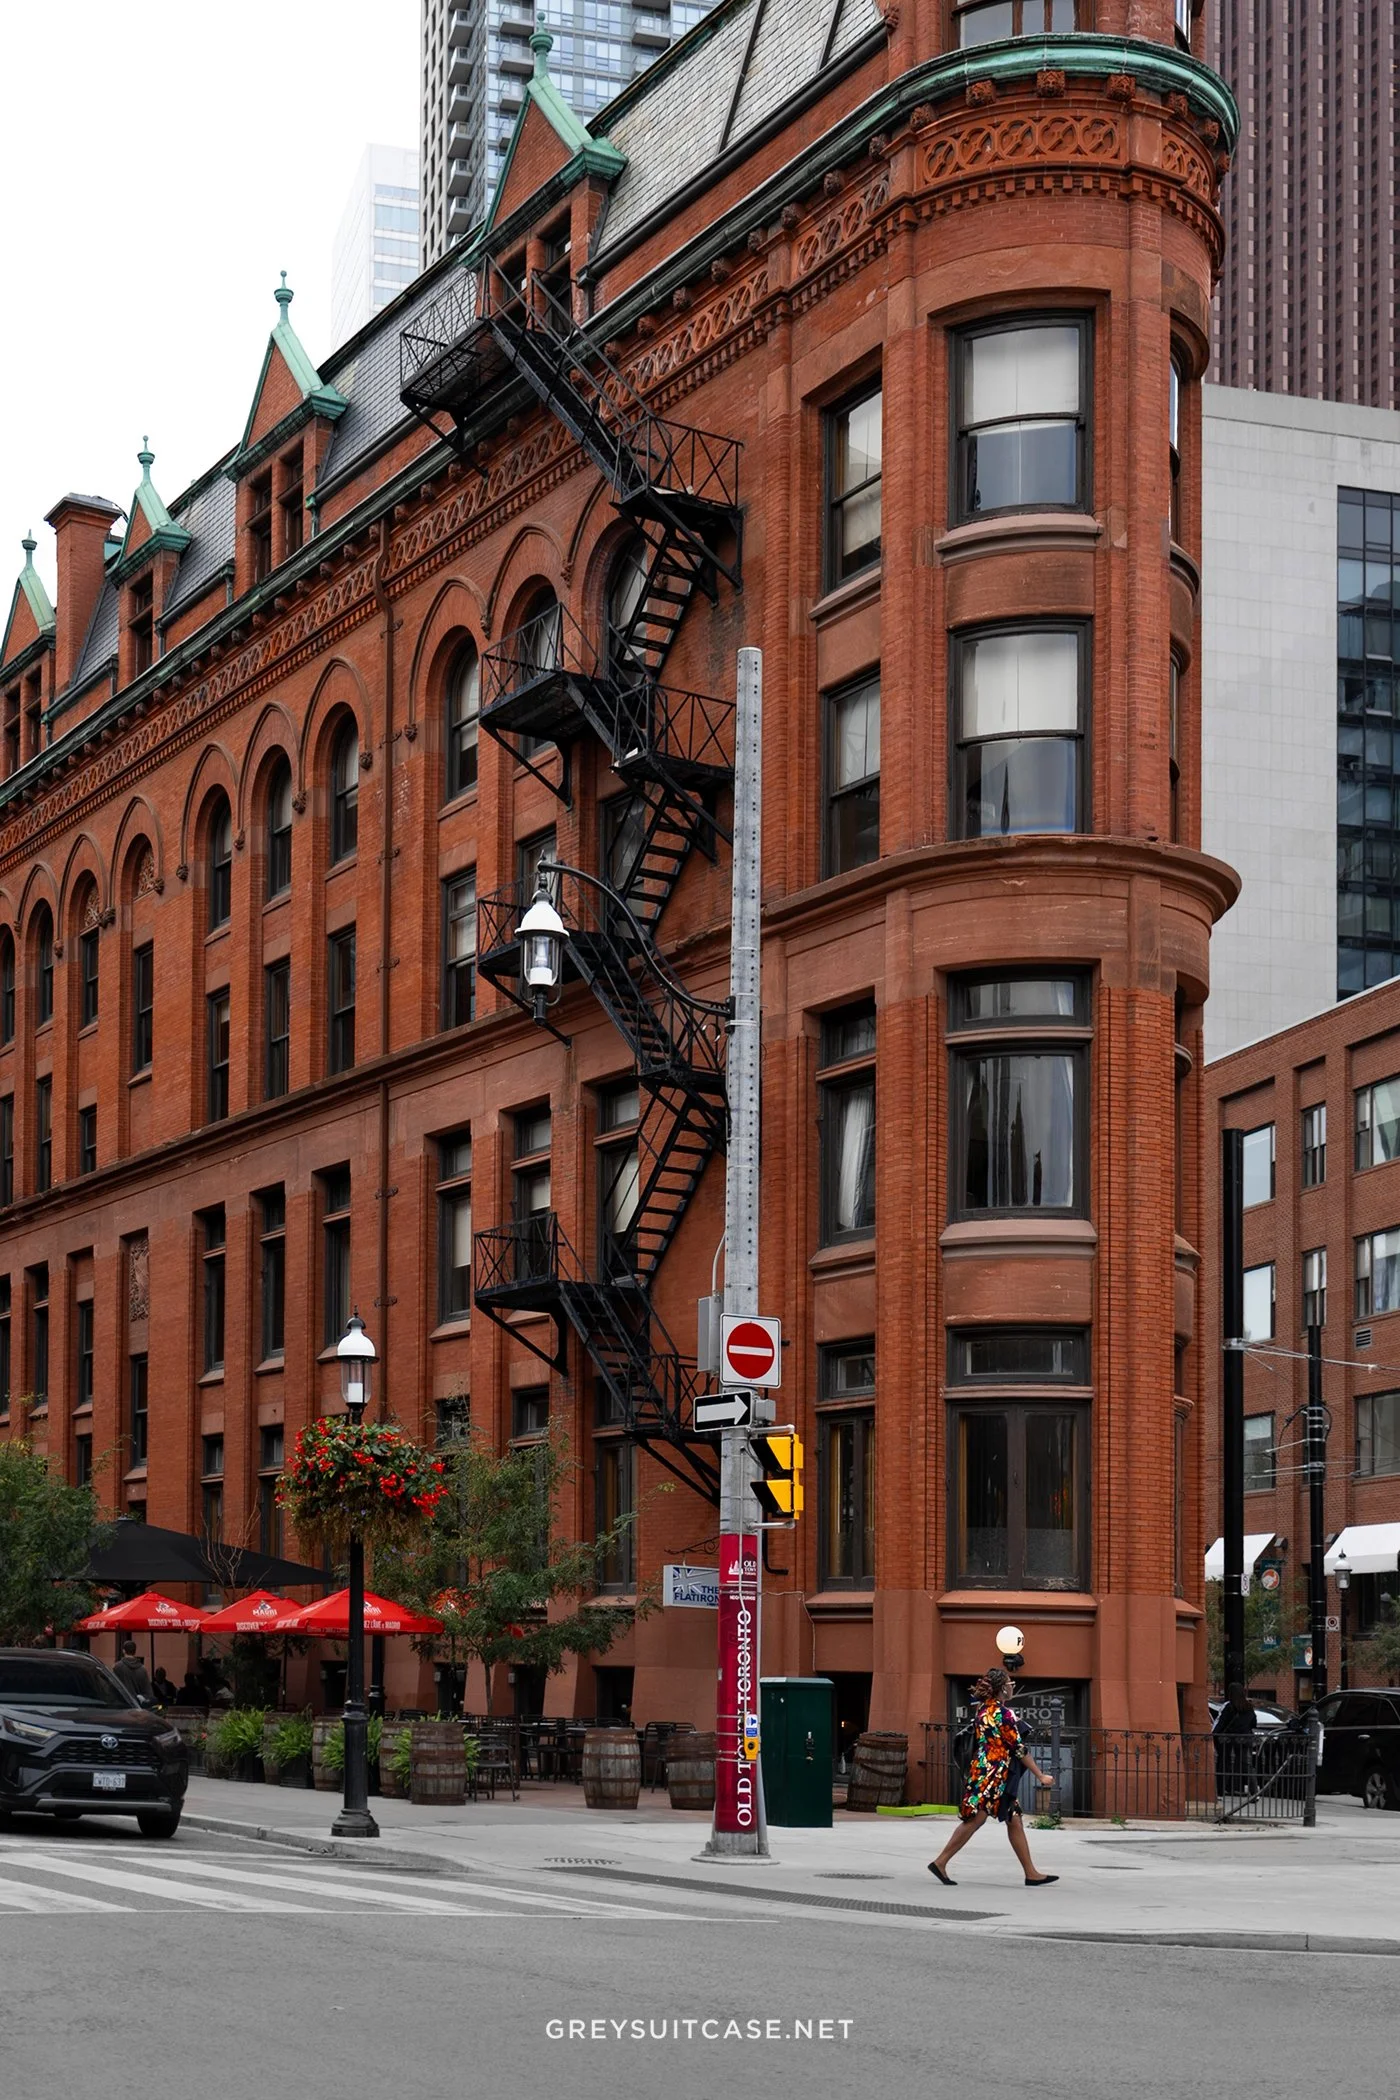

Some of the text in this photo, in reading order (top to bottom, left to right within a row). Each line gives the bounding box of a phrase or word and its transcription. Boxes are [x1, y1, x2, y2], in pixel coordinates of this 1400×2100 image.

[701, 1585, 719, 1594] THE
[737, 1609, 752, 1705] TORONTO
[737, 1777, 752, 1827] OLD
